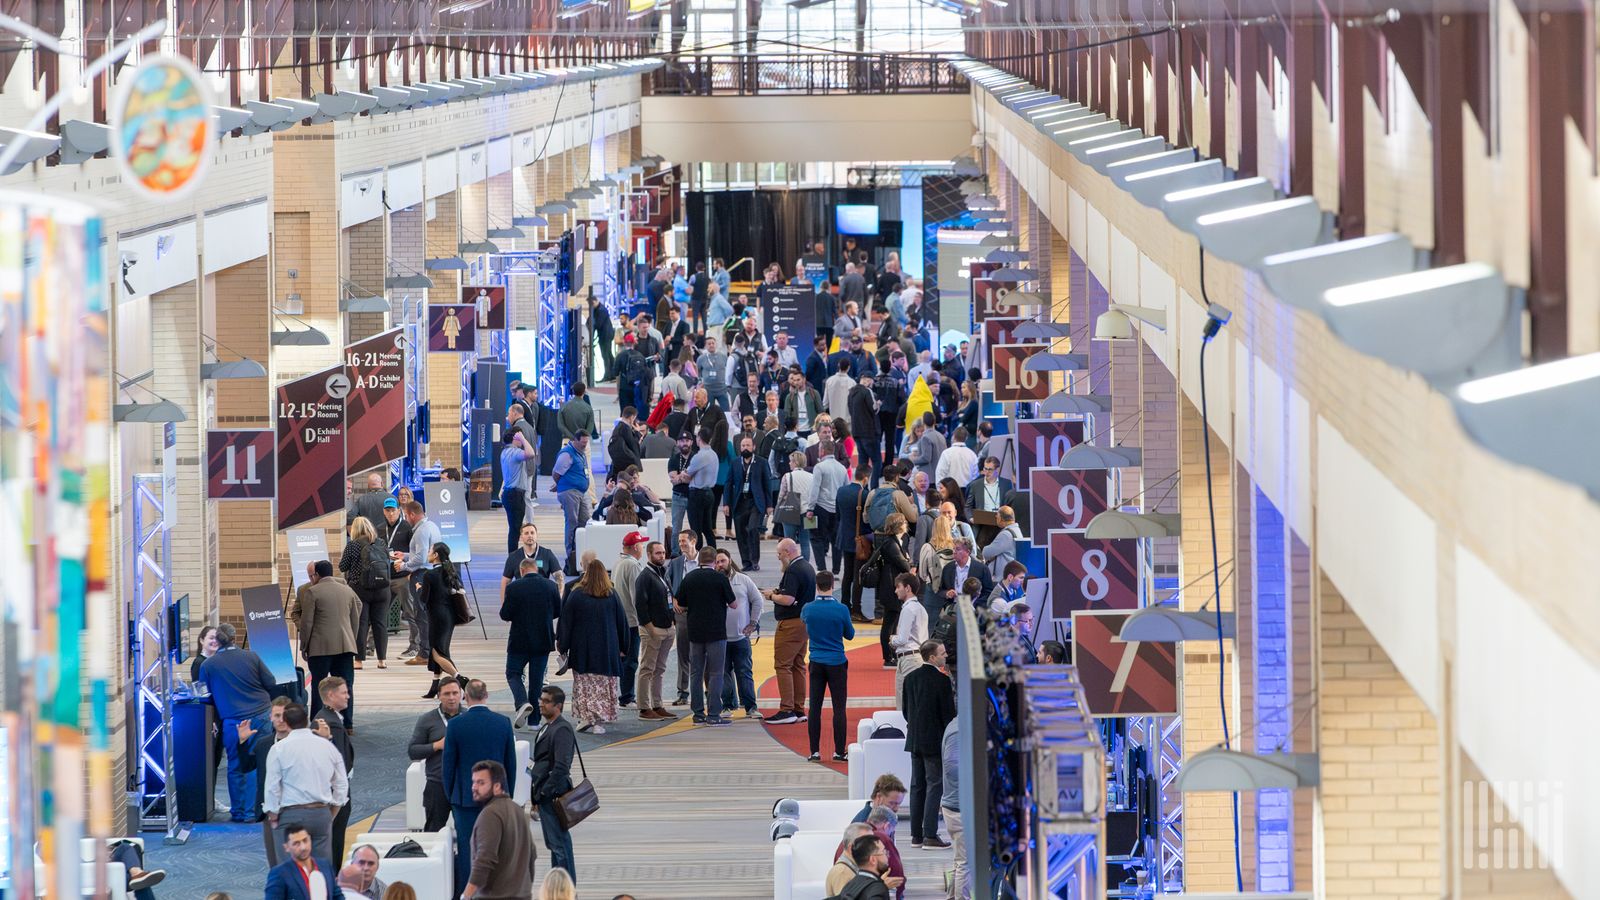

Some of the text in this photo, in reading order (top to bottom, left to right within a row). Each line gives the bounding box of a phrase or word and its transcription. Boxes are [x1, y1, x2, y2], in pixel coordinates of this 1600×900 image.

[983, 287, 1010, 315] 18
[346, 352, 401, 367] 16-21 Meeting
[379, 359, 399, 367] Rooms
[1005, 356, 1039, 390] 16
[355, 374, 401, 389] A-D Exhibit
[279, 402, 343, 418] 12-15 Meeting
[305, 427, 341, 443] D Exhibit
[317, 435, 330, 443] Hall
[222, 444, 261, 485] 11
[1035, 434, 1072, 467] 10
[1057, 484, 1083, 529] 9
[1080, 549, 1110, 601] 8
[1109, 635, 1141, 693] 7
